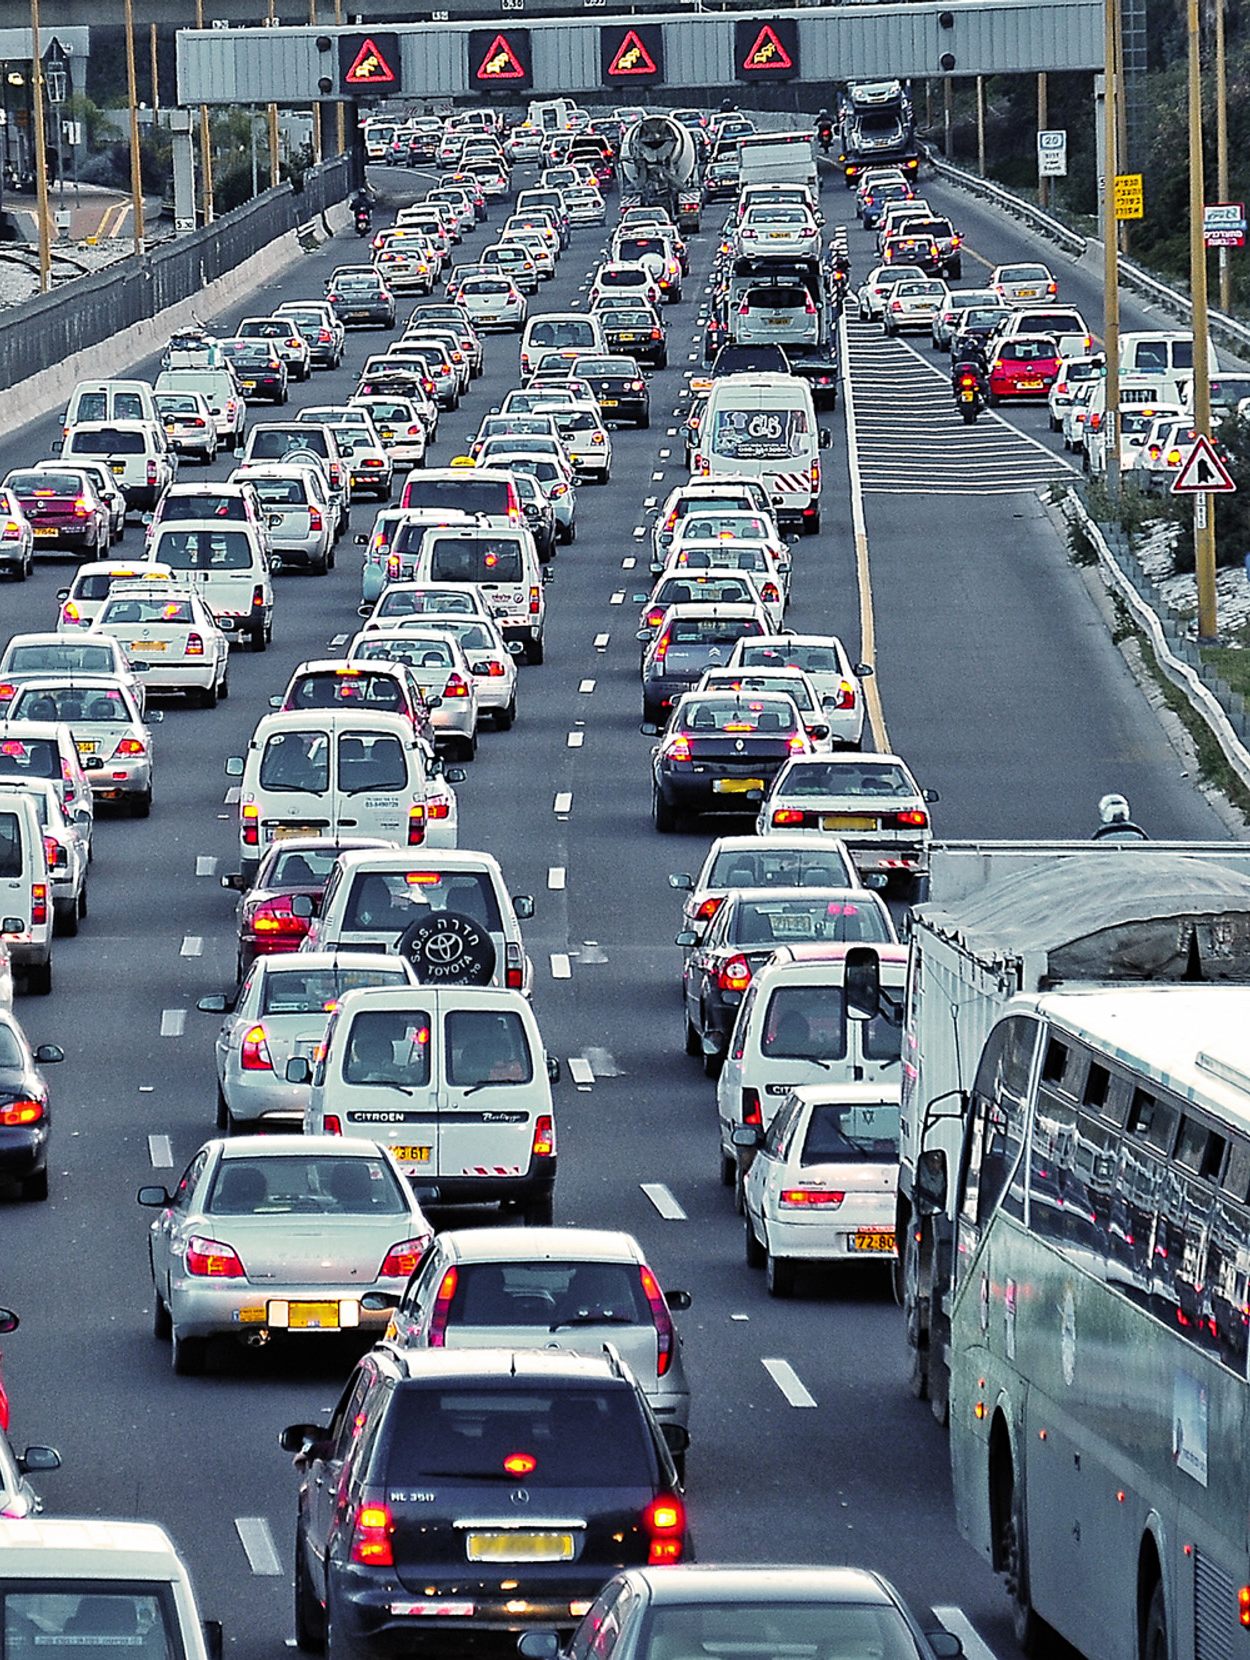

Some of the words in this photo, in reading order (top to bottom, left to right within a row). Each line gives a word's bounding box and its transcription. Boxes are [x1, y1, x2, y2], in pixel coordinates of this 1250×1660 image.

[1045, 136, 1059, 145] 20
[437, 919, 479, 946] חדרה
[428, 954, 473, 977] TOYOTA
[772, 1085, 792, 1095] CIT
